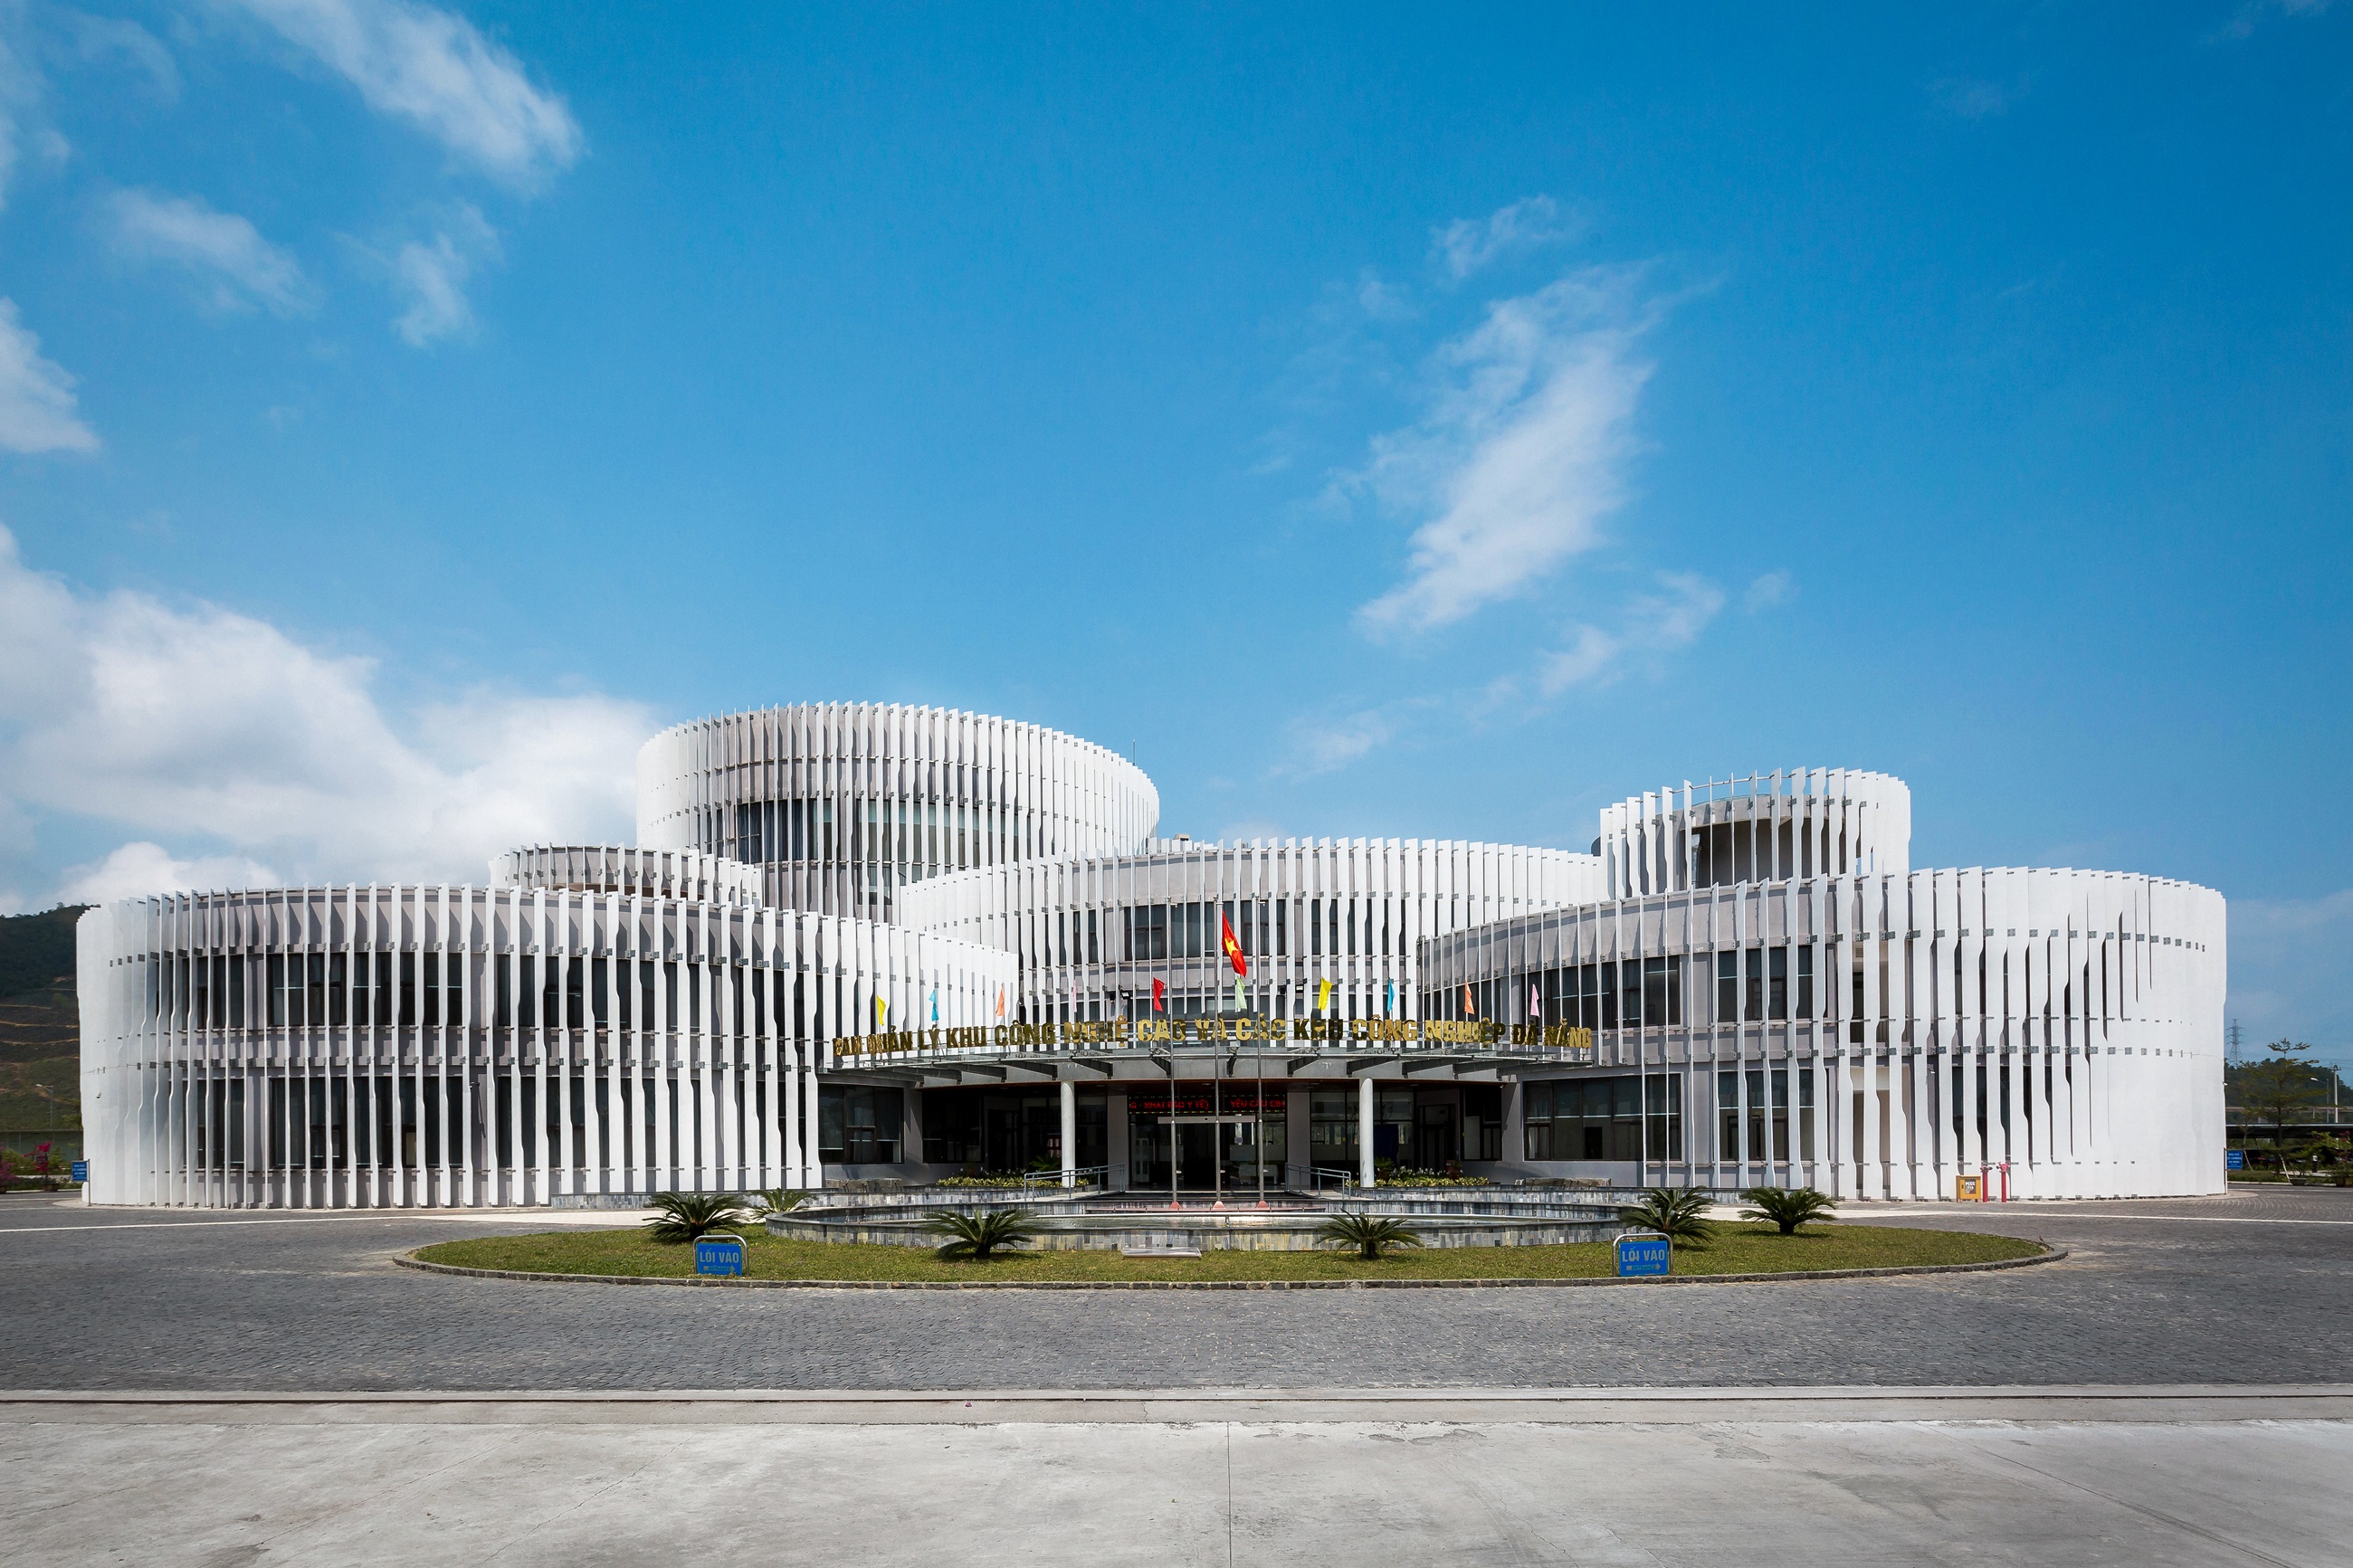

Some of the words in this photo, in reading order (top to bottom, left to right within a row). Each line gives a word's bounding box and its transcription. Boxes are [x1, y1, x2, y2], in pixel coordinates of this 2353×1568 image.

[918, 1024, 940, 1050] LÝ
[946, 1026, 987, 1048] KHU
[995, 1020, 1056, 1047] CÔNG
[1063, 1014, 1129, 1048] NGHỆ
[1137, 1018, 1186, 1041] CAO
[1235, 1012, 1286, 1041] CÁC
[1293, 1018, 1344, 1041] KHU
[1352, 1014, 1417, 1041] CÔNG
[1424, 1017, 1506, 1048] NGHIỆP
[700, 1248, 715, 1263] LỐI
[719, 1250, 739, 1263] VÀO
[1622, 1246, 1640, 1262] LỐI
[1643, 1247, 1665, 1261] VÀO
